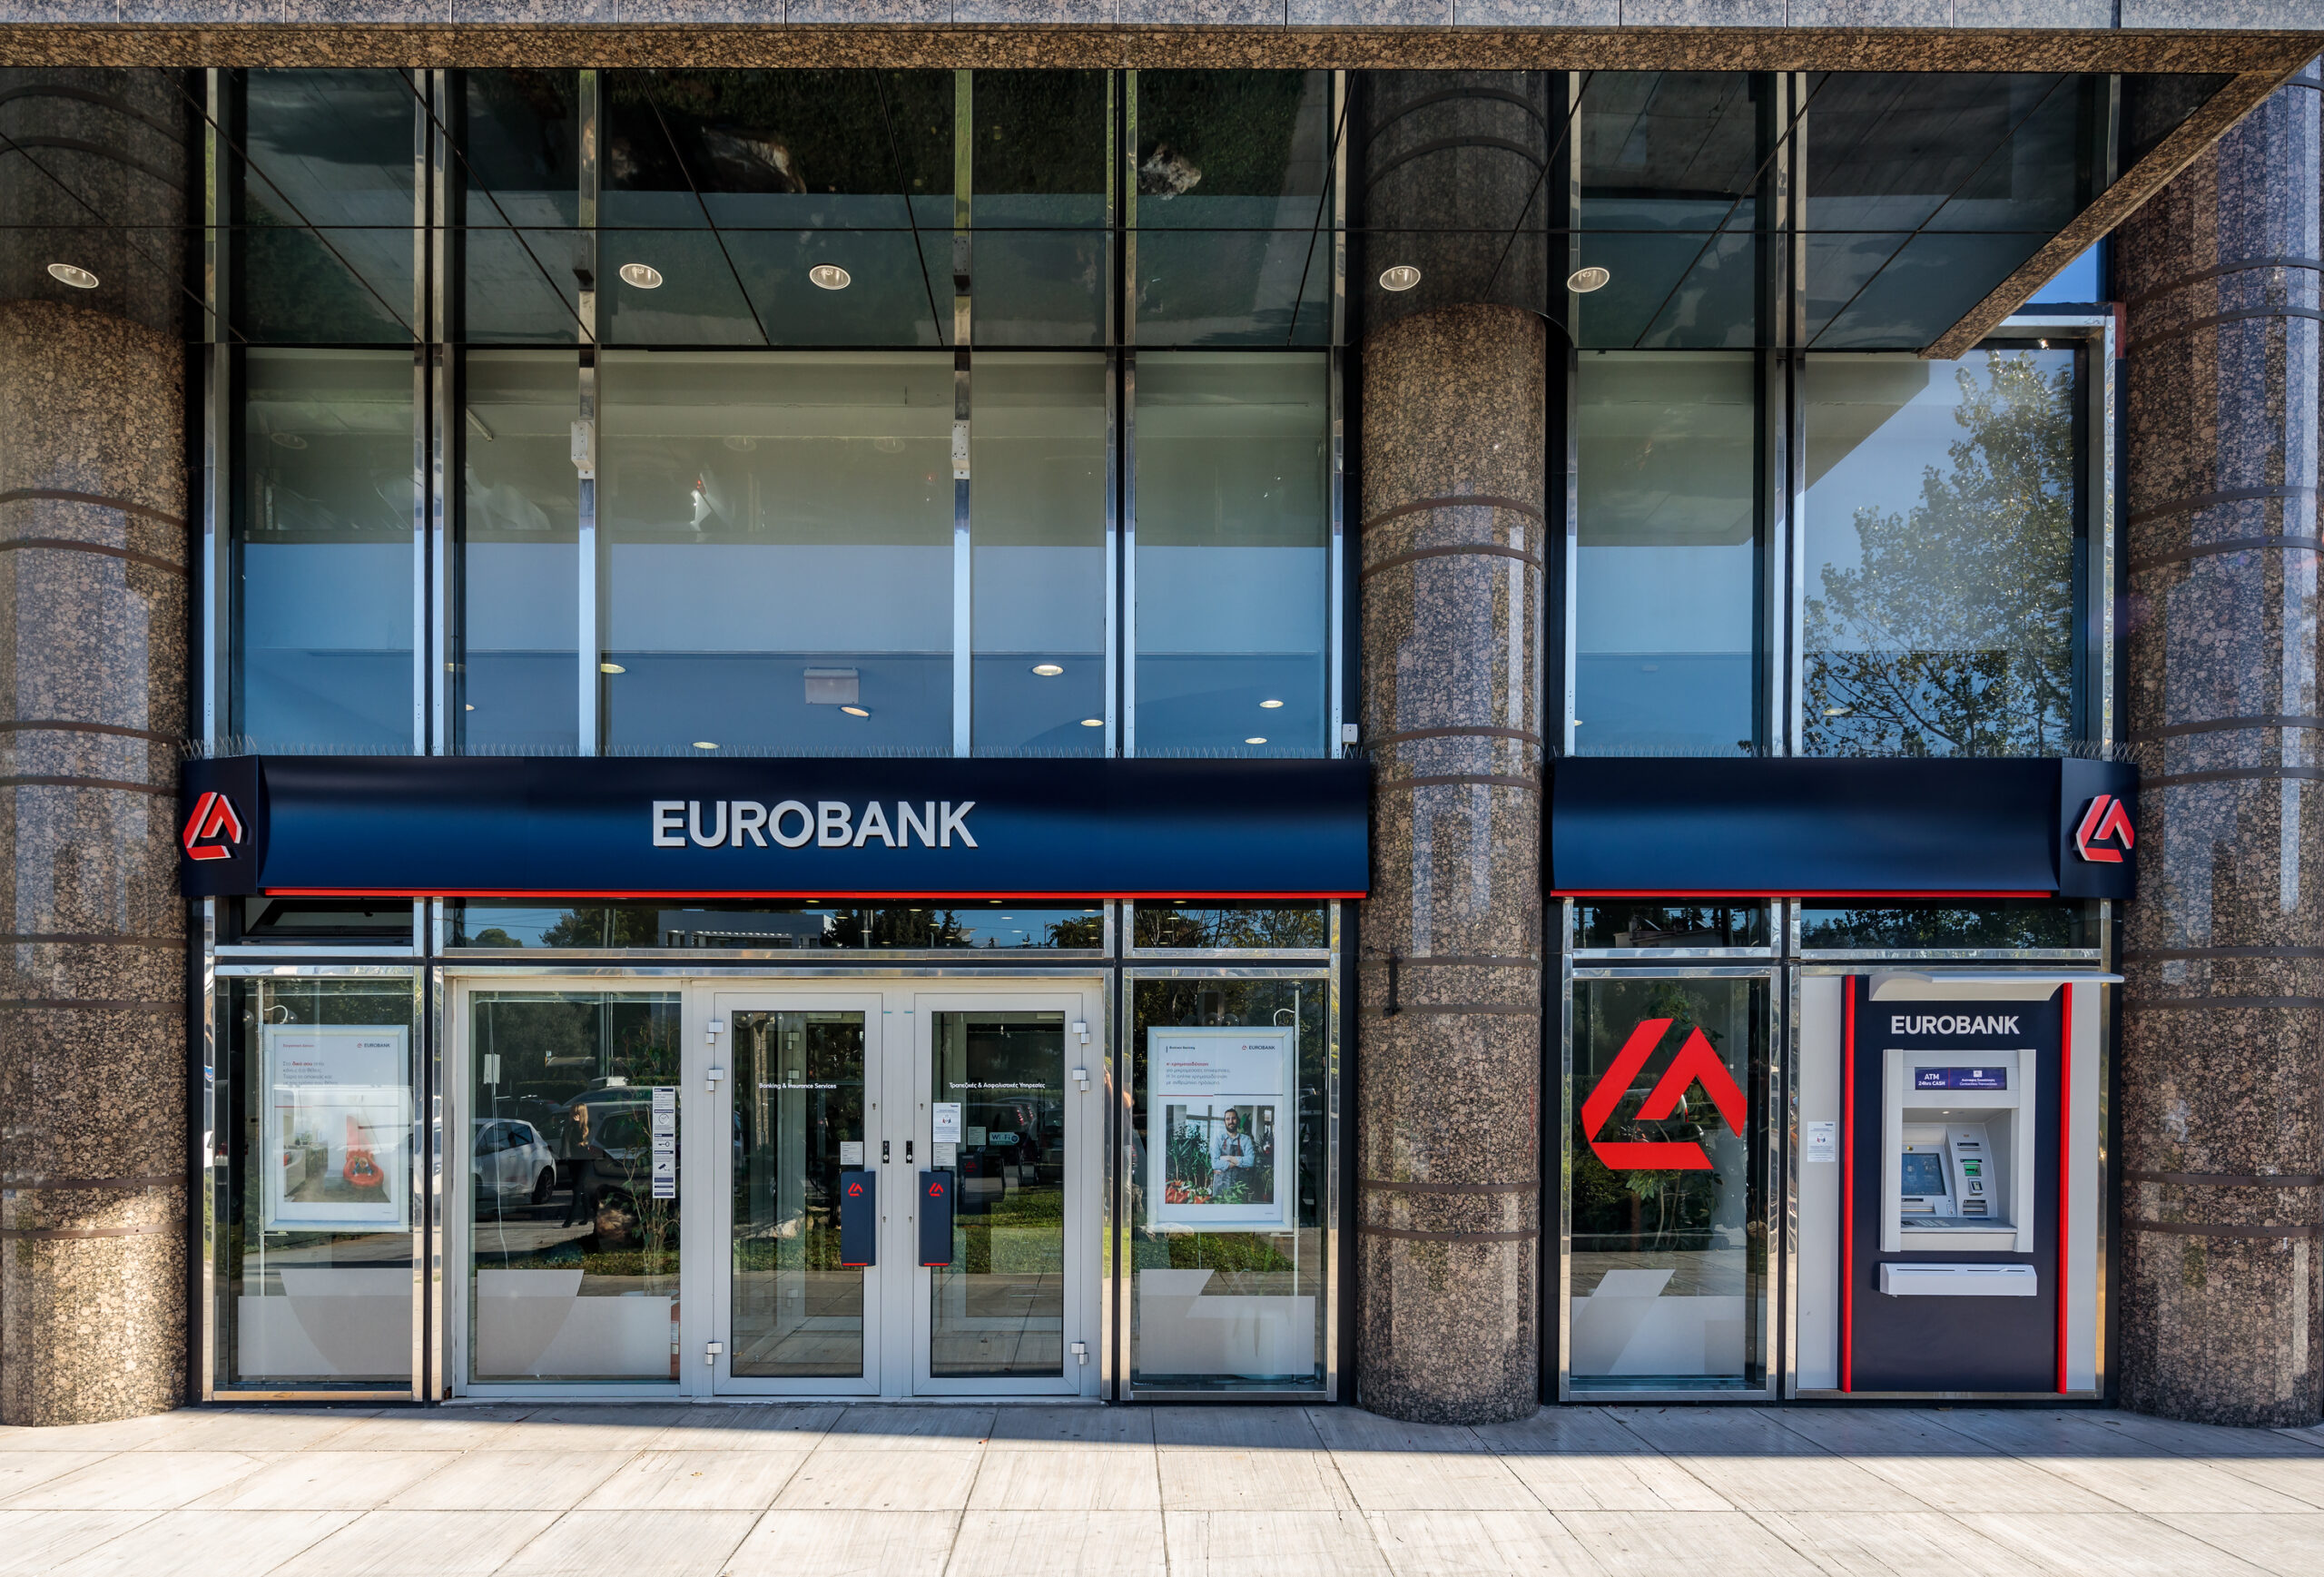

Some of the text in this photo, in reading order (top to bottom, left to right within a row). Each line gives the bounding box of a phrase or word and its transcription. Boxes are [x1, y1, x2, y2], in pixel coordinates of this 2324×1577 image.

[653, 800, 979, 848] EUROBANK
[1891, 1015, 2021, 1035] EUROBANK
[983, 1081, 1019, 1089] Ασφαλιστικές
[1019, 1081, 1046, 1089] Υπηρεσίες
